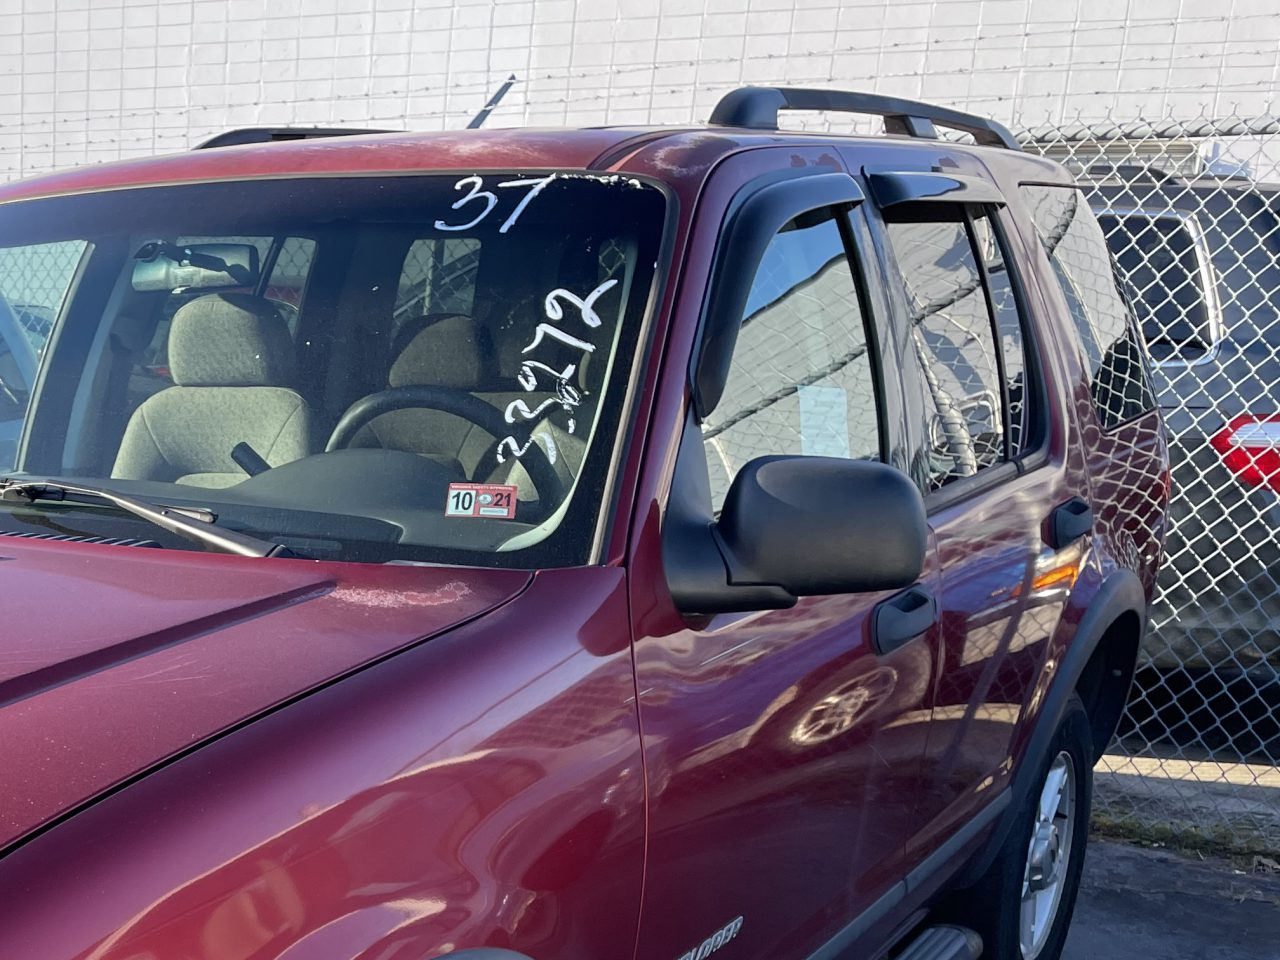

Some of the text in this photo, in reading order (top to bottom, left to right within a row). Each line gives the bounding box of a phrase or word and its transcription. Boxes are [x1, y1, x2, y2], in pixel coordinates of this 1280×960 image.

[433, 172, 556, 233] 37
[451, 491, 512, 511] 10 21
